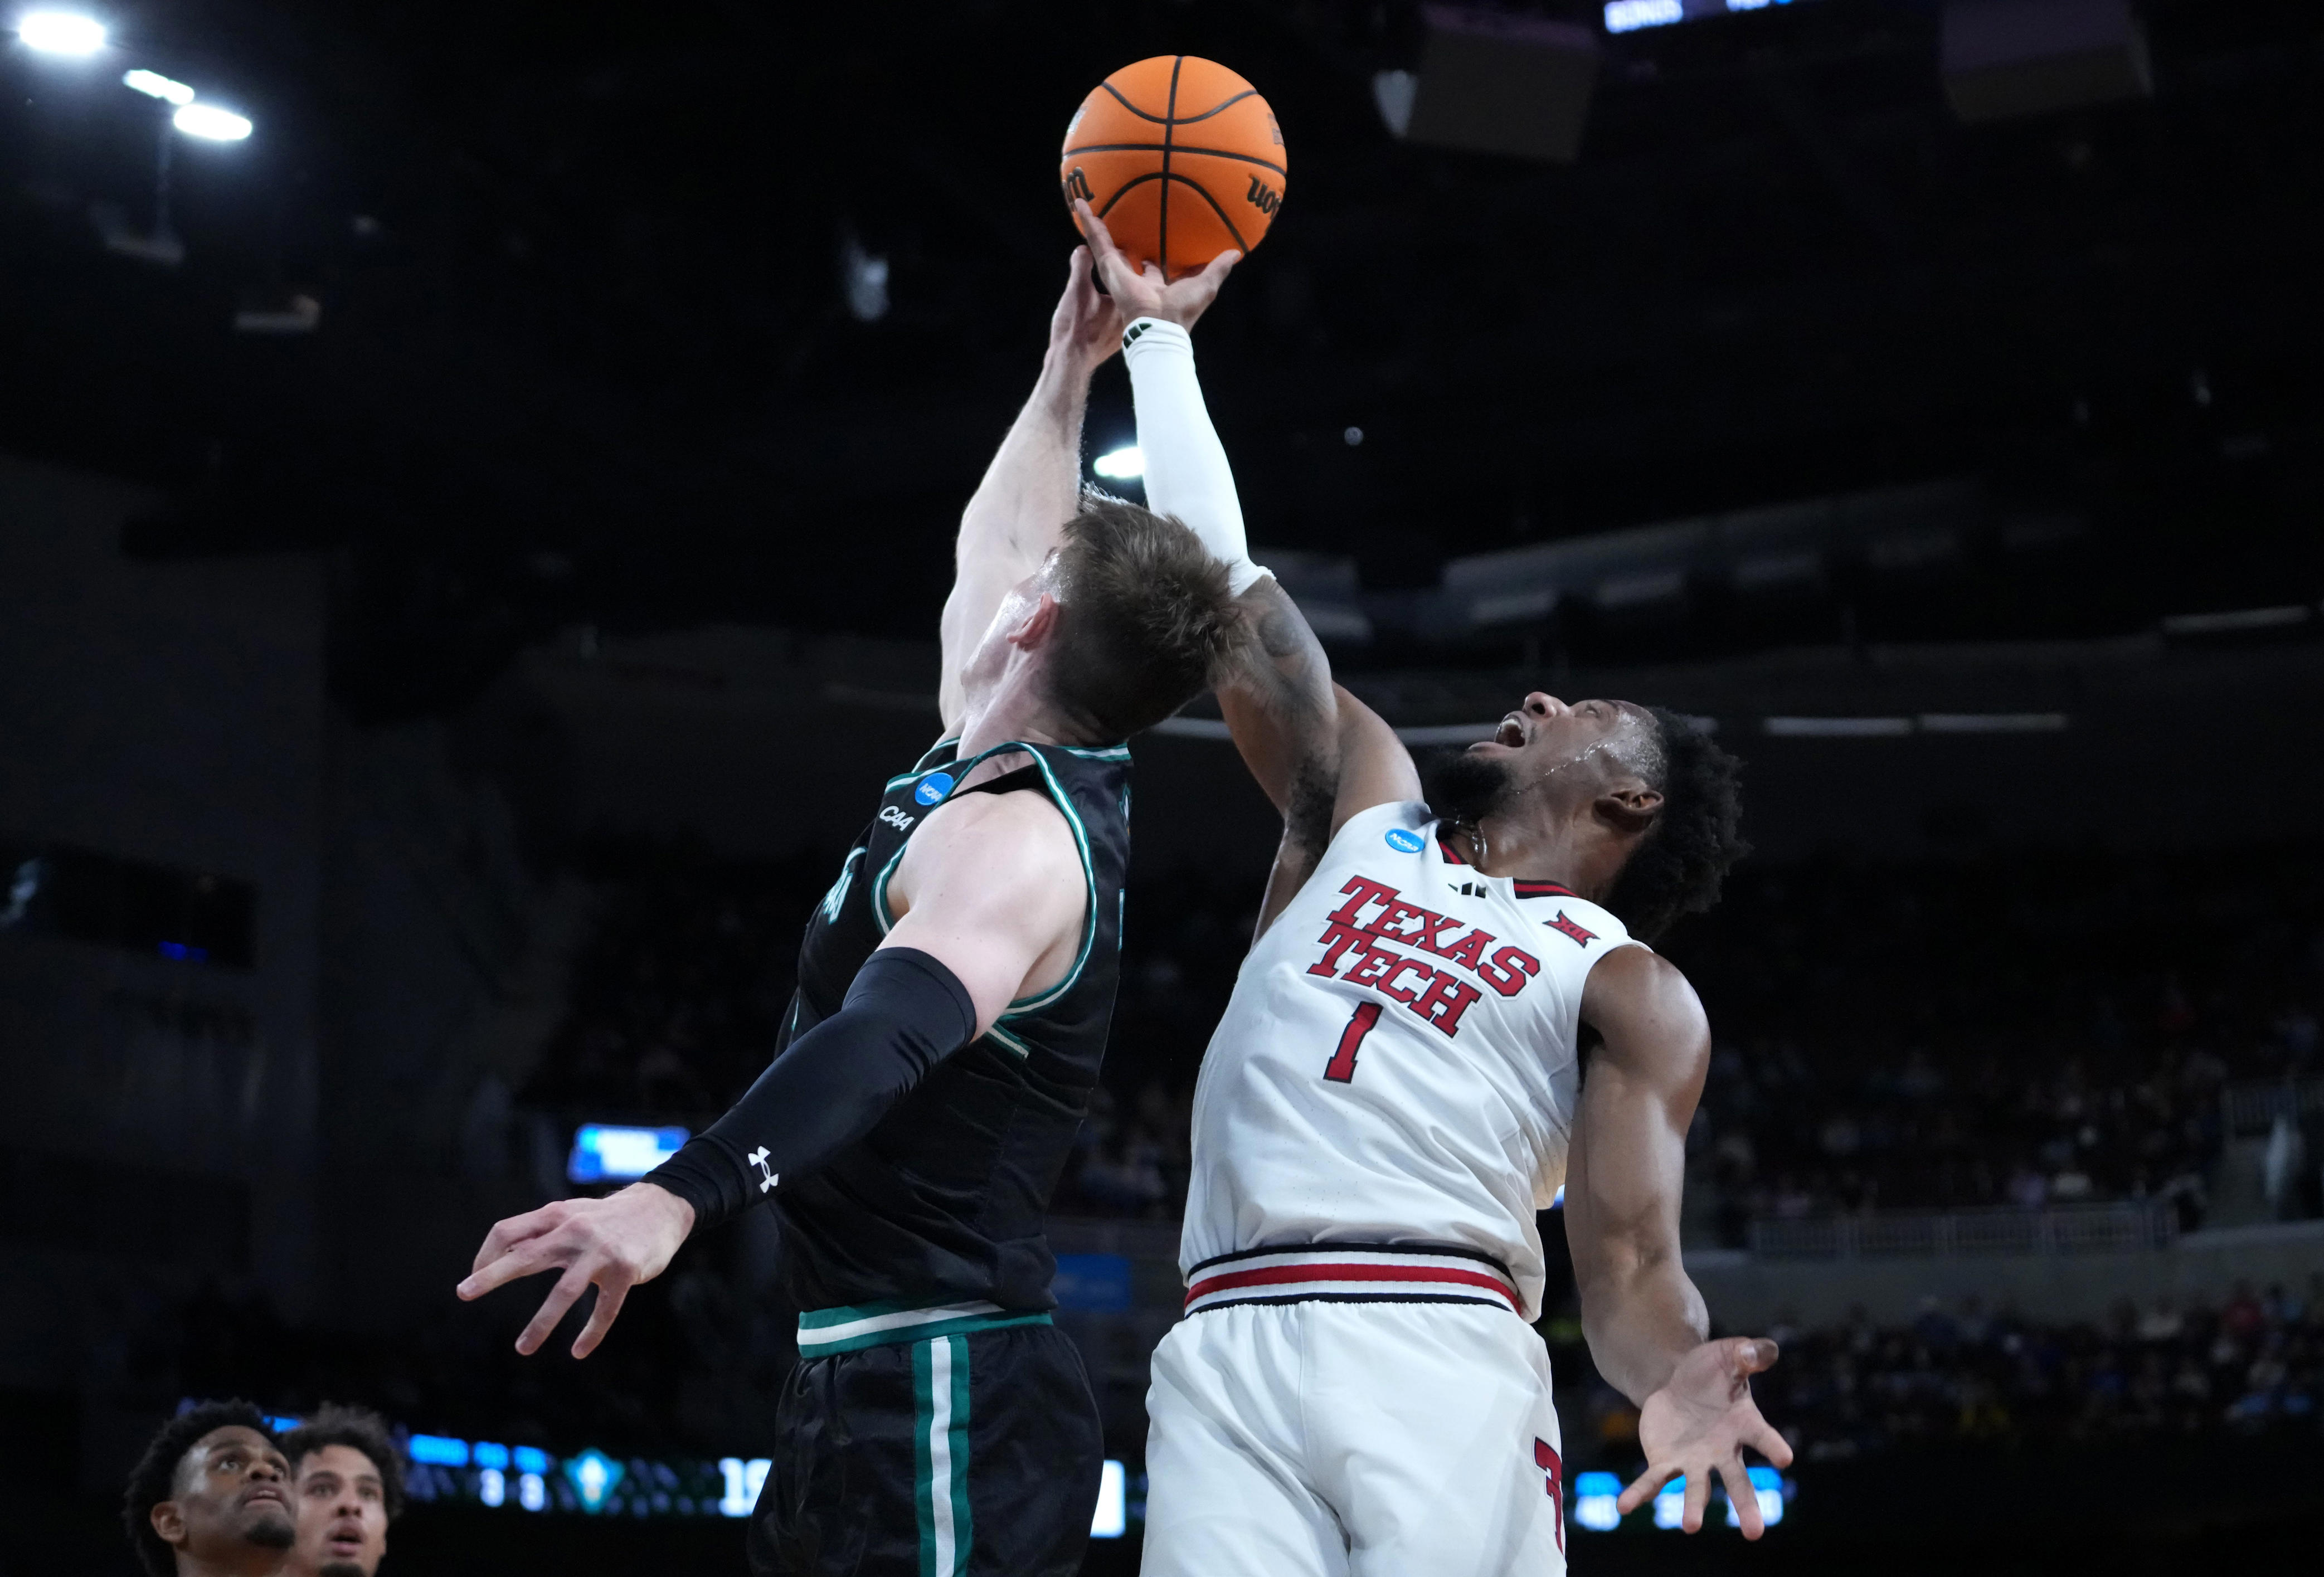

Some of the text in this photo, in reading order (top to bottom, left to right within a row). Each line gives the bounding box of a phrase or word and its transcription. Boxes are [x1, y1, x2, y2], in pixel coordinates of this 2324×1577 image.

[879, 806, 915, 831] CAA
[920, 782, 944, 802] NCAA
[1326, 874, 1541, 997] TEXAS
[1306, 921, 1483, 1039] TECH
[1323, 1001, 1383, 1084] 1
